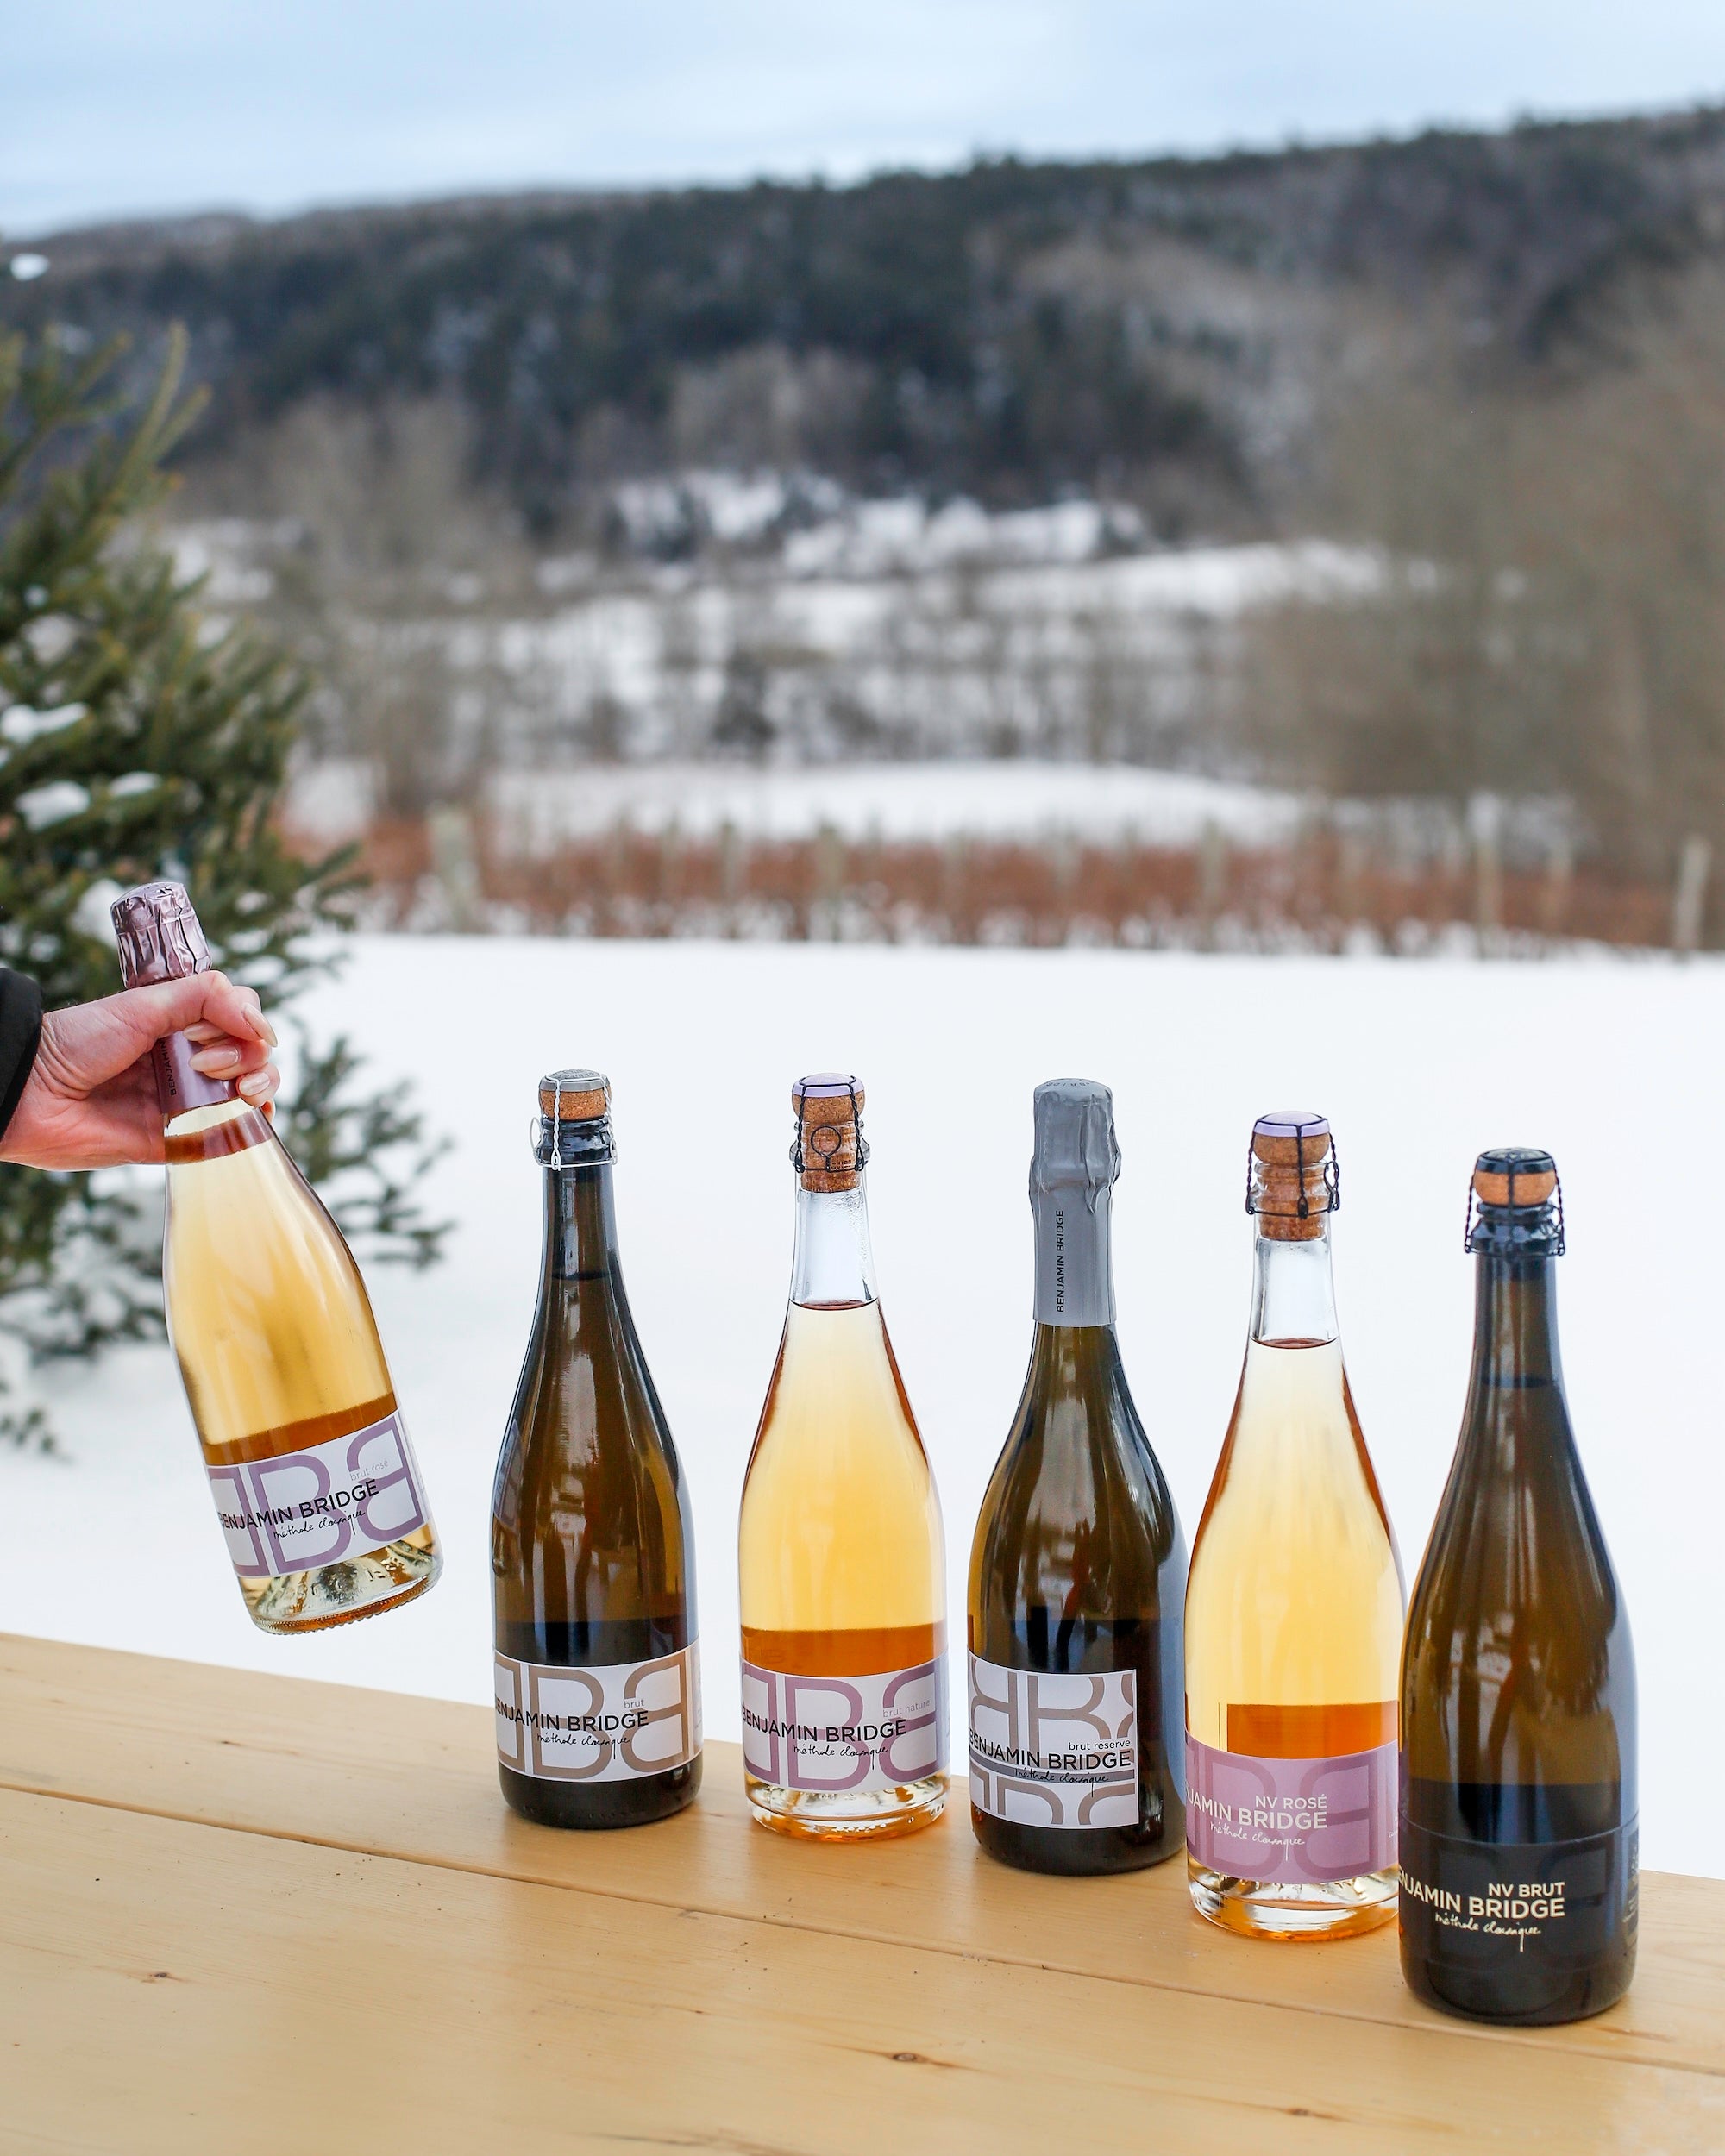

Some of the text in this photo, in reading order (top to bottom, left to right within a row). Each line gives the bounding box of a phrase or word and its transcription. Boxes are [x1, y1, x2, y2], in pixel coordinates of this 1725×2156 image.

[160, 1041, 177, 1096] BENJAMIN
[349, 1459, 389, 1482] brut rosé
[298, 1478, 380, 1520] BRIDGE
[495, 1694, 649, 1732] ENJAMIN BRIDGE
[624, 1698, 645, 1709] brut
[882, 1699, 931, 1718] brut nature
[826, 1719, 906, 1742] BRIDGE
[1069, 1739, 1131, 1751] brut reserve
[1048, 1750, 1132, 1770] BRIDGE
[1255, 1794, 1327, 1809] NV ROSÉ
[1239, 1810, 1327, 1830] BRIDGE
[1488, 1881, 1565, 1898] NV BRUT
[1468, 1896, 1566, 1919] BRIDGE
